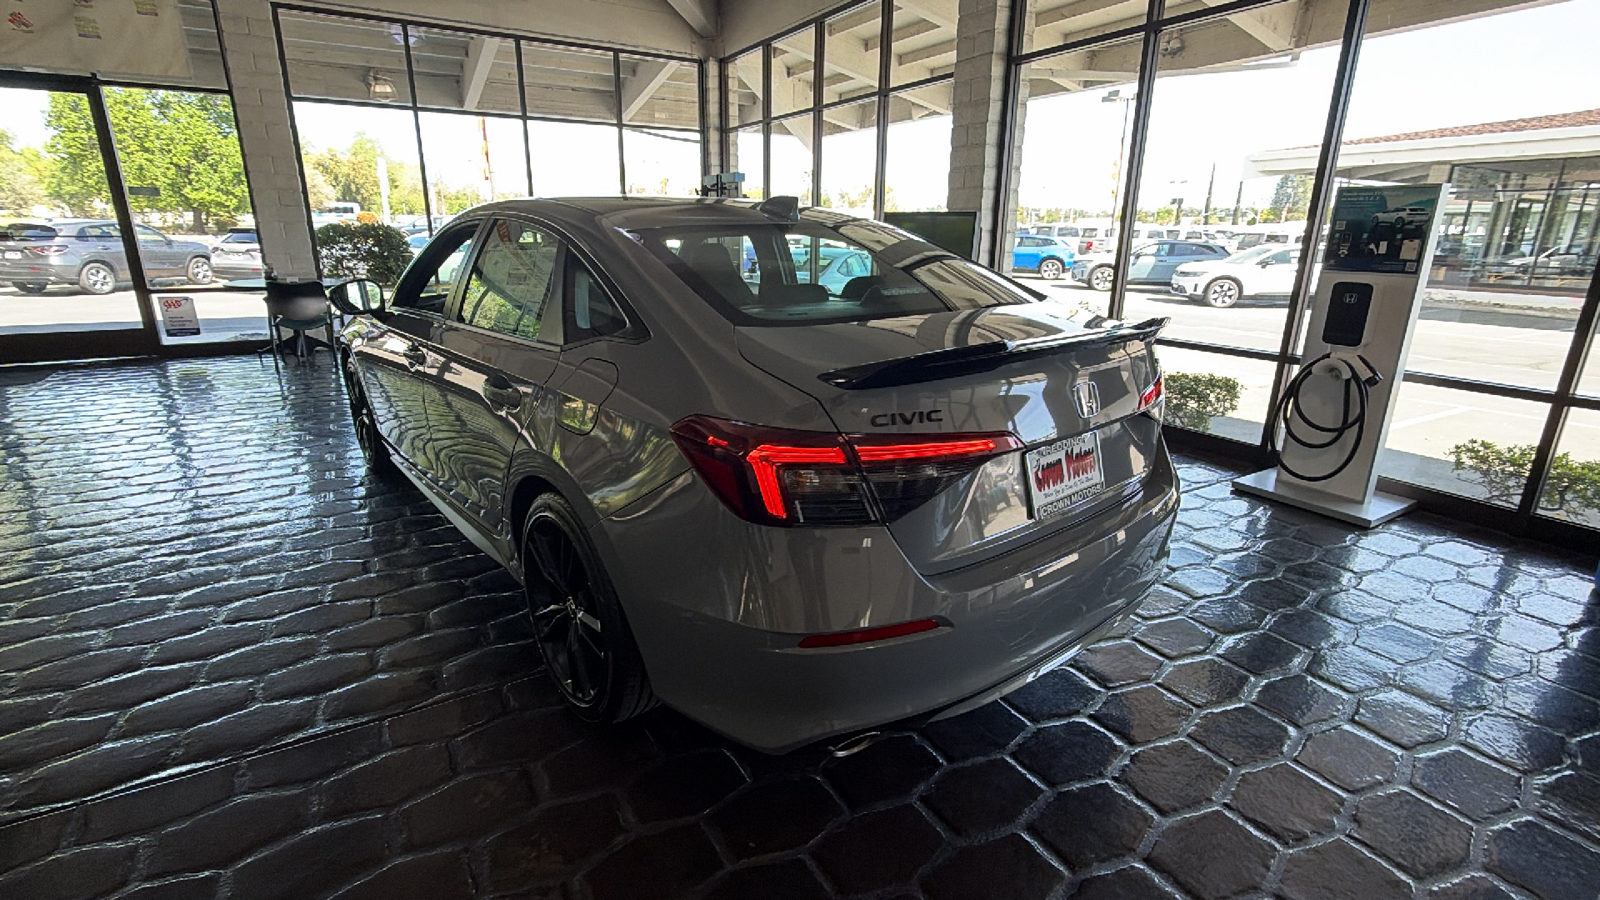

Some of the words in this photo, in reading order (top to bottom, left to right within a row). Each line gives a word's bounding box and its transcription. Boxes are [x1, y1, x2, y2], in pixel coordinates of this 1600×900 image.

[870, 409, 943, 427] CIVIC
[1045, 436, 1086, 454] REDDING
[1033, 457, 1064, 493] Crown
[1041, 497, 1071, 516] CROWN
[1071, 484, 1101, 504] MOTORS
